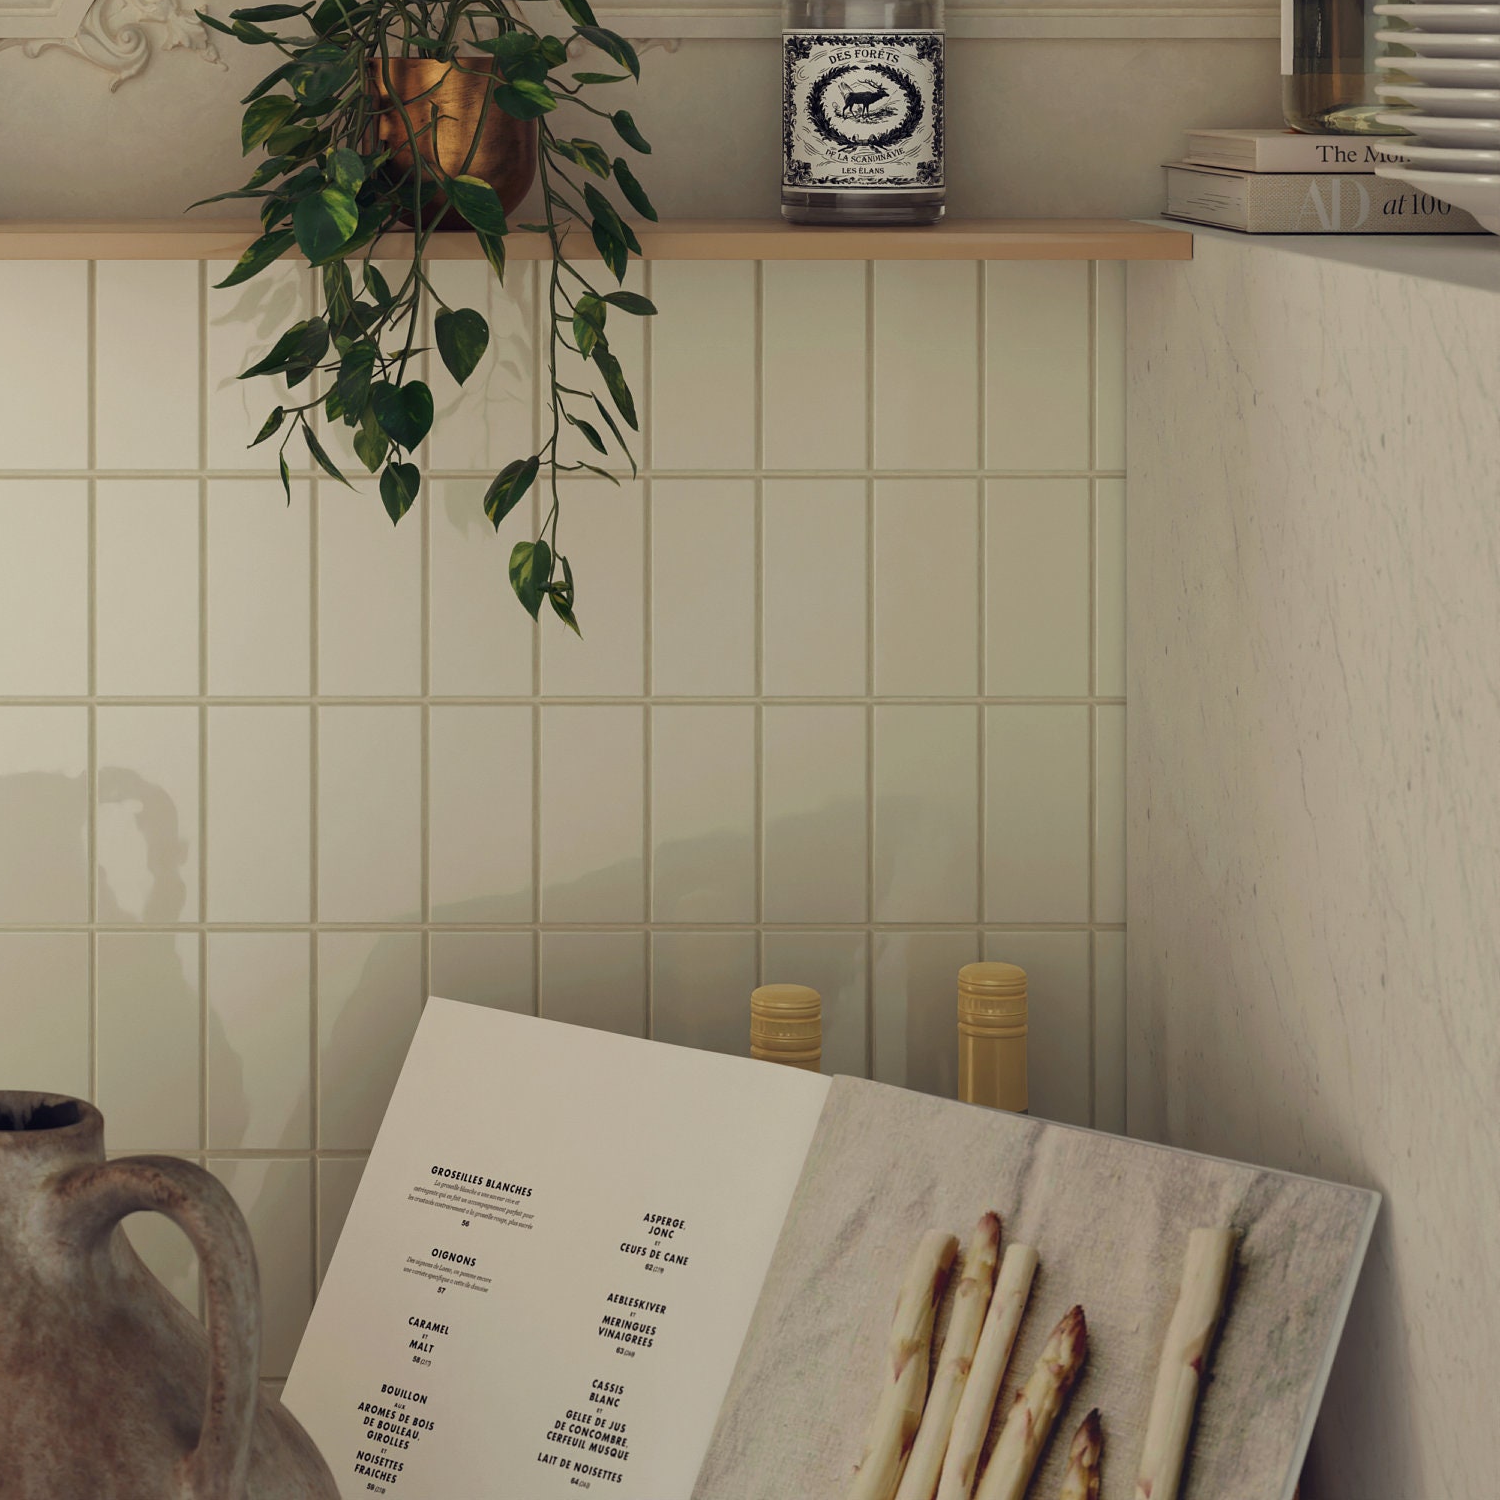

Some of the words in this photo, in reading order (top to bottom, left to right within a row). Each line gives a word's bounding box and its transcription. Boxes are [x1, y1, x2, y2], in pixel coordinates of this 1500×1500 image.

[829, 51, 852, 64] DES
[838, 152, 848, 162] LA
[851, 147, 905, 162] SCANDINAVIE
[1316, 145, 1357, 162] The
[1296, 179, 1371, 230] AD
[1383, 193, 1407, 215] at
[431, 1166, 484, 1185] GROSEILLES
[486, 1179, 532, 1197] BLANCHES
[648, 1226, 675, 1238] JONC
[431, 1248, 476, 1267] OIGNONS
[650, 1250, 661, 1259] DE
[664, 1253, 688, 1266] CANE
[607, 1293, 667, 1314] AEBLESKIVER
[408, 1316, 449, 1335] CARAMEL
[602, 1315, 657, 1336] MERINGUES
[598, 1326, 654, 1347] VINAIGREES
[409, 1340, 434, 1353] MALT
[381, 1384, 428, 1404] BOUILLON
[592, 1379, 624, 1395] CASSIS
[589, 1392, 620, 1407] BLANC
[358, 1402, 396, 1419] AROMES
[398, 1413, 410, 1424] DE
[412, 1418, 435, 1431] BOIS
[363, 1417, 375, 1427] DE
[554, 1420, 566, 1430] DE
[566, 1410, 592, 1424] GELEE
[594, 1417, 607, 1428] DE
[609, 1421, 626, 1433] JUS
[367, 1430, 410, 1450] GIROLLES
[547, 1431, 586, 1449] CERFEUIL
[589, 1443, 630, 1461] MUSQUE
[356, 1451, 404, 1472] NOISETTES
[537, 1453, 558, 1465] LAIT
[559, 1458, 572, 1469] DE
[574, 1462, 623, 1483] NOISETTES
[354, 1464, 398, 1483] FRAICHES
